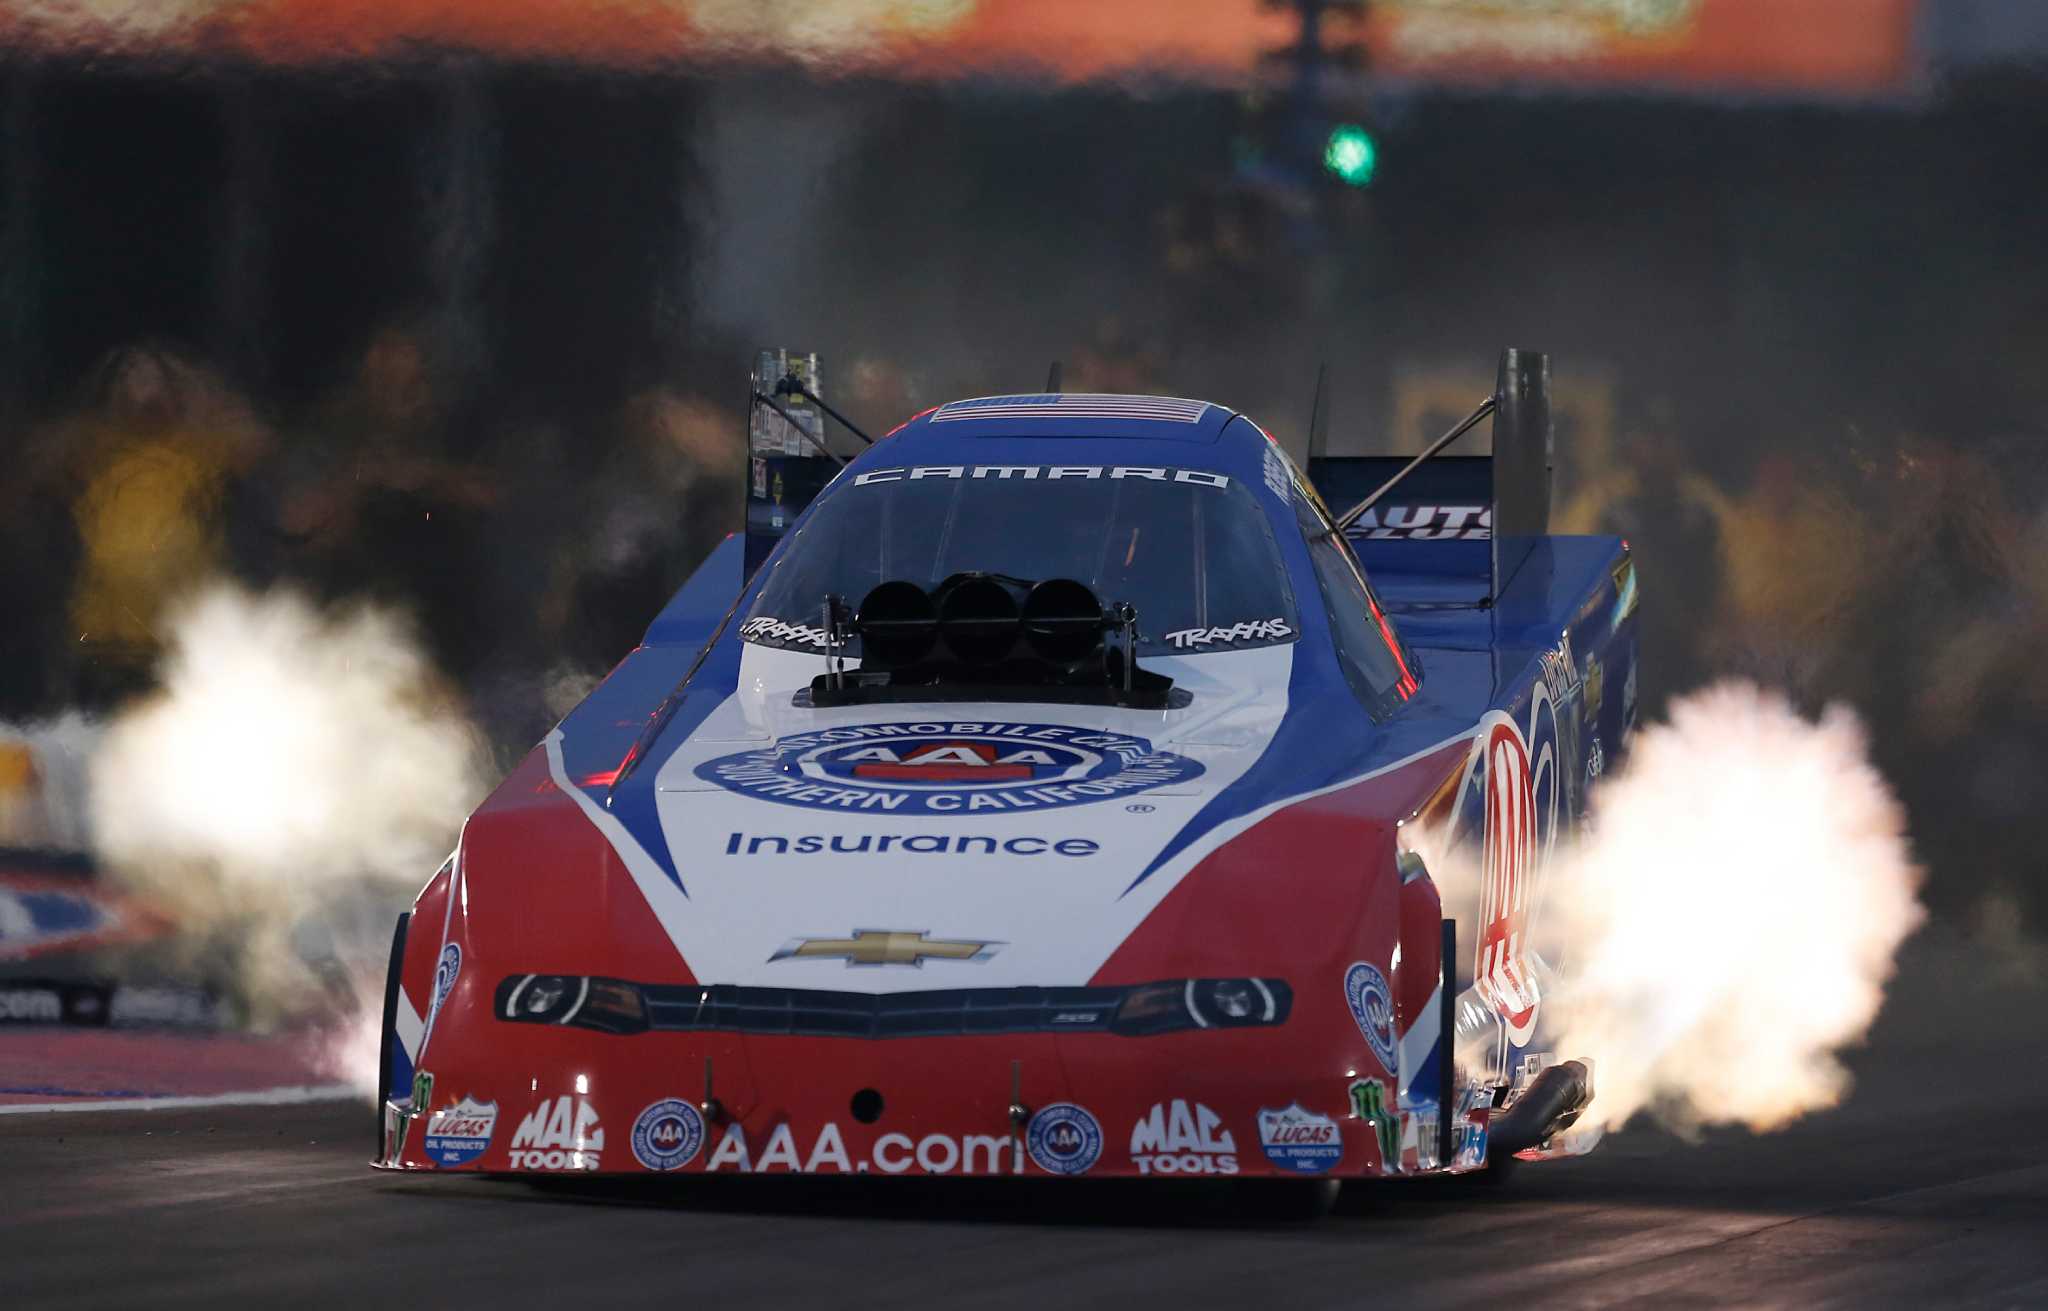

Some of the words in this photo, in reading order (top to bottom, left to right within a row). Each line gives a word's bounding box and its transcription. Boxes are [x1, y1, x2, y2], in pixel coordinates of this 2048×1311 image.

[855, 465, 1229, 488] CAMARO
[1166, 618, 1292, 648] TRAXXAS
[838, 746, 1056, 767] AAA
[725, 832, 1101, 857] Insurance
[432, 1117, 491, 1137] LUCAS
[511, 1095, 604, 1151] MAC
[1130, 1098, 1237, 1154] MAC
[652, 1124, 684, 1143] AAA
[1048, 1127, 1081, 1146] AAA
[1271, 1125, 1333, 1144] LUCAS
[440, 1139, 486, 1150] PRODUCTS
[705, 1122, 1025, 1174] AAA.com
[1287, 1148, 1340, 1158] PRODUCTS
[508, 1151, 599, 1170] TOOLS
[1131, 1154, 1240, 1174] TOOLS
